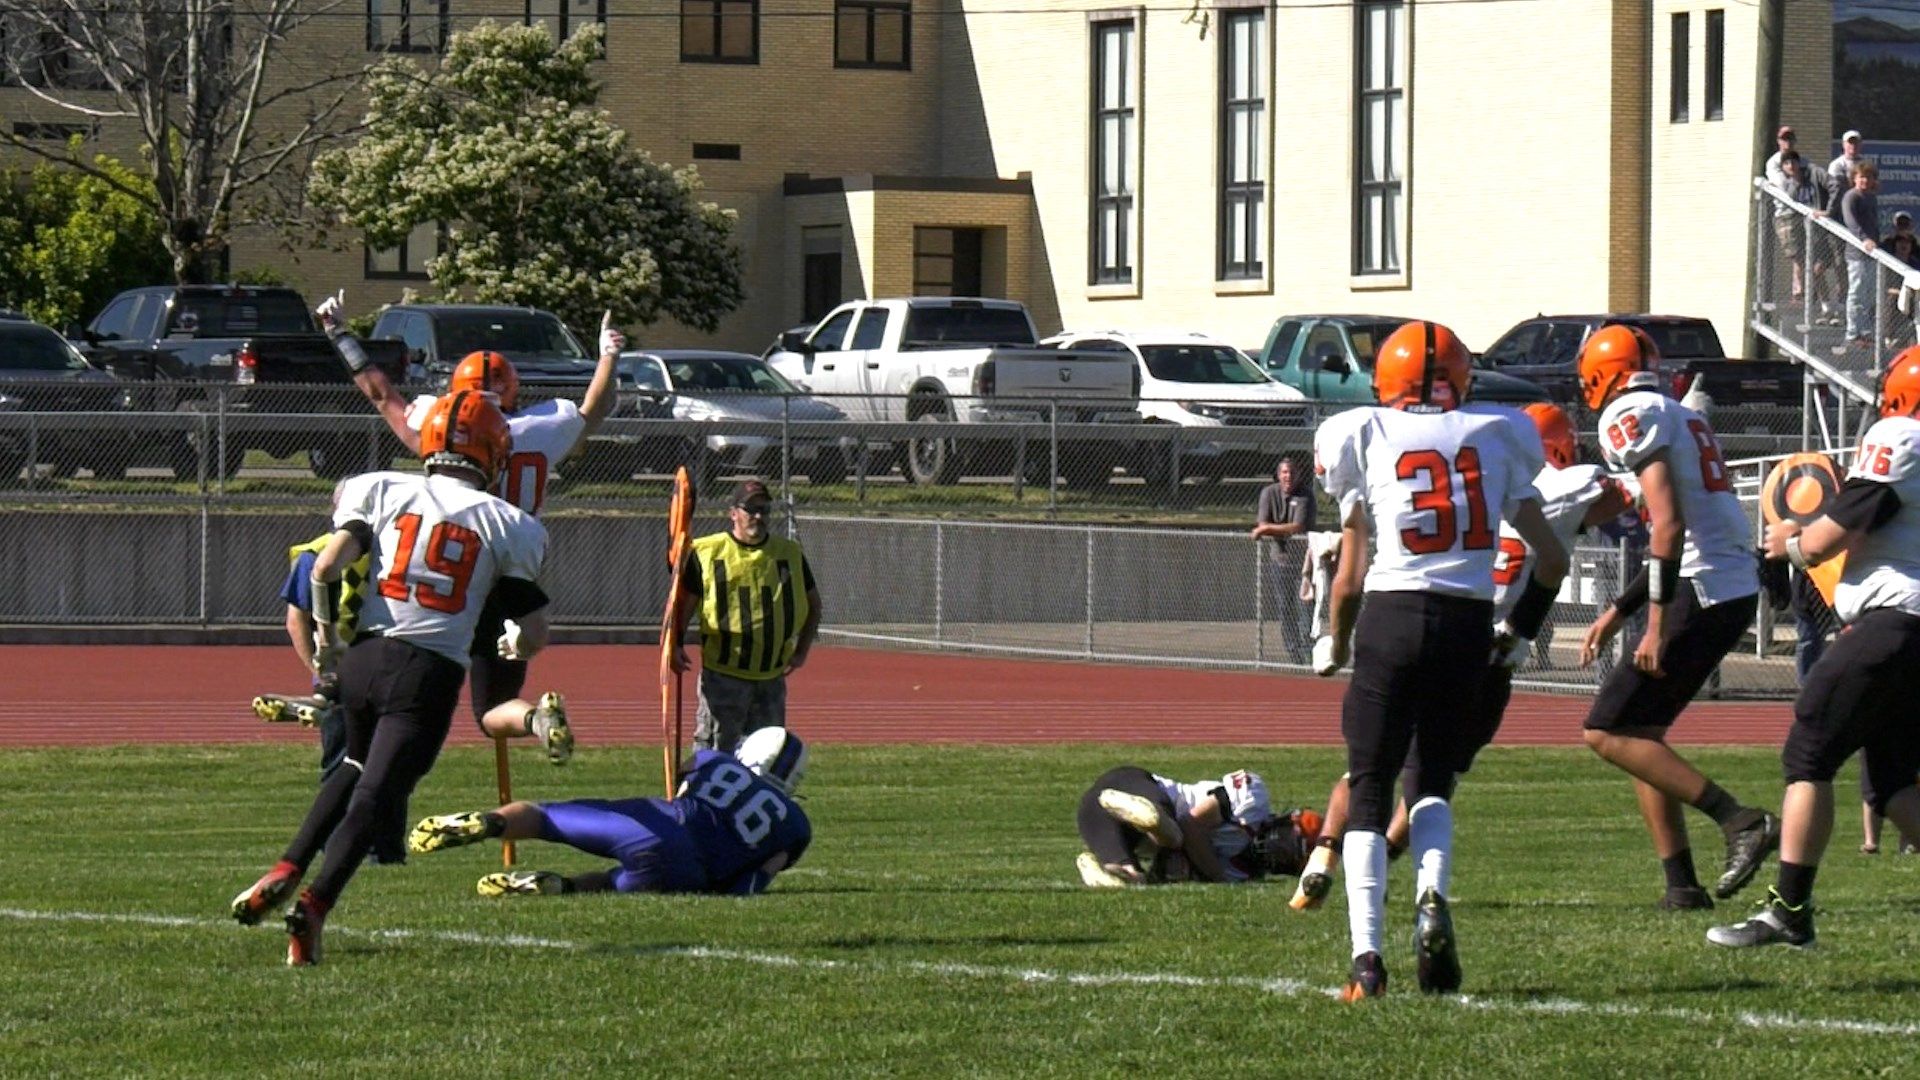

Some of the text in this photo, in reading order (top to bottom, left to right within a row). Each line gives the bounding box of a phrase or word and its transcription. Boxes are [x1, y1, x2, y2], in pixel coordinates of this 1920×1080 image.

[1607, 414, 1643, 450] 82
[1860, 444, 1893, 475] 76
[1395, 446, 1494, 554] 31
[377, 513, 483, 615] 19
[696, 762, 788, 845] 86
